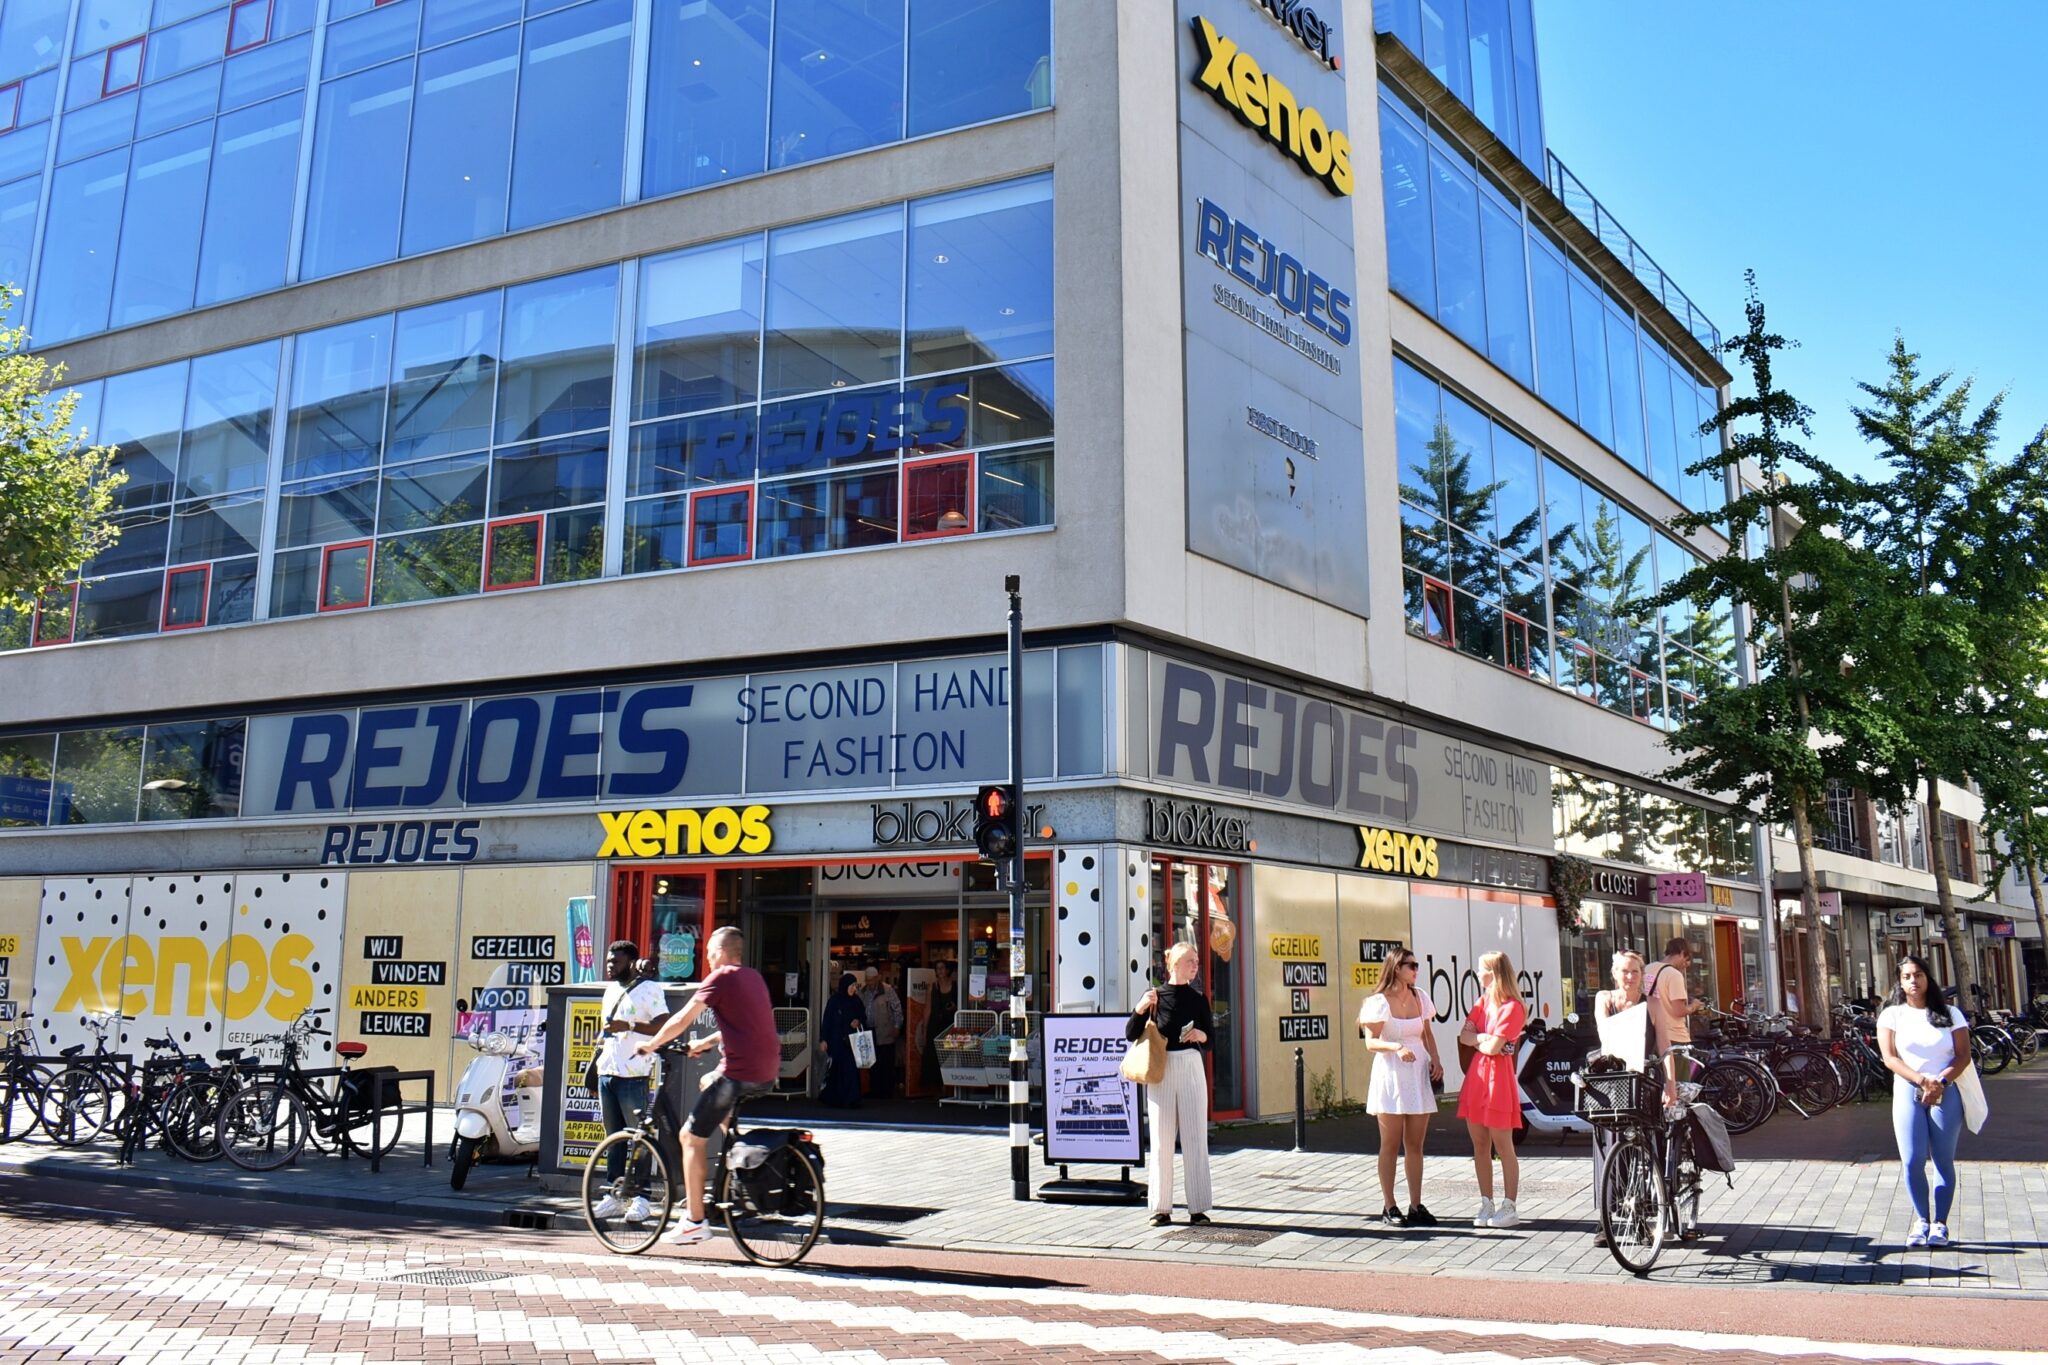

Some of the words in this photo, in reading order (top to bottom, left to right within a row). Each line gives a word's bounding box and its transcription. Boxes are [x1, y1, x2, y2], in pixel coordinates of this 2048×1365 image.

[1192, 15, 1354, 197] xenos
[1196, 196, 1352, 346] REJOES
[1214, 283, 1258, 323] SECOND
[1261, 311, 1292, 344] HAND
[1295, 333, 1341, 376] FASHION
[701, 383, 968, 478] REJOES
[1247, 405, 1280, 438] FIRST
[736, 677, 887, 726] SECOND
[274, 684, 695, 812] REJOES
[1157, 661, 1420, 822] REJOES
[783, 729, 966, 779] FASHION
[1443, 745, 1498, 787] SECOND
[1505, 762, 1538, 798] HAND
[870, 800, 1054, 845] blokr.
[1463, 795, 1525, 836] FASHION
[321, 820, 481, 865] REJOES
[596, 804, 773, 859] xenos
[1358, 826, 1440, 879] xenos
[1600, 872, 1638, 897] CLOSET
[370, 938, 398, 957] WIJ
[473, 937, 554, 958] GEZELLIG
[1271, 936, 1320, 958] GEZELLIG
[1362, 942, 1377, 960] WE
[52, 932, 316, 1022] xenos
[378, 963, 441, 983] VINDEN
[510, 964, 562, 984] THUIS
[1284, 964, 1326, 985] WONEN
[354, 988, 419, 1008] ANDERS
[474, 988, 527, 1009] VOOR
[1427, 954, 1550, 1024] bloer.
[1292, 990, 1309, 1012] EN
[365, 1013, 425, 1035] LEUKER
[1281, 1018, 1327, 1040] TAFELEN
[572, 1050, 591, 1058] 22/23
[1053, 1038, 1128, 1054] REJOES
[567, 1101, 602, 1110] AQUAR
[566, 1122, 583, 1131] ARP
[577, 1131, 582, 1139] &
[565, 1147, 594, 1156] FESTIVA
